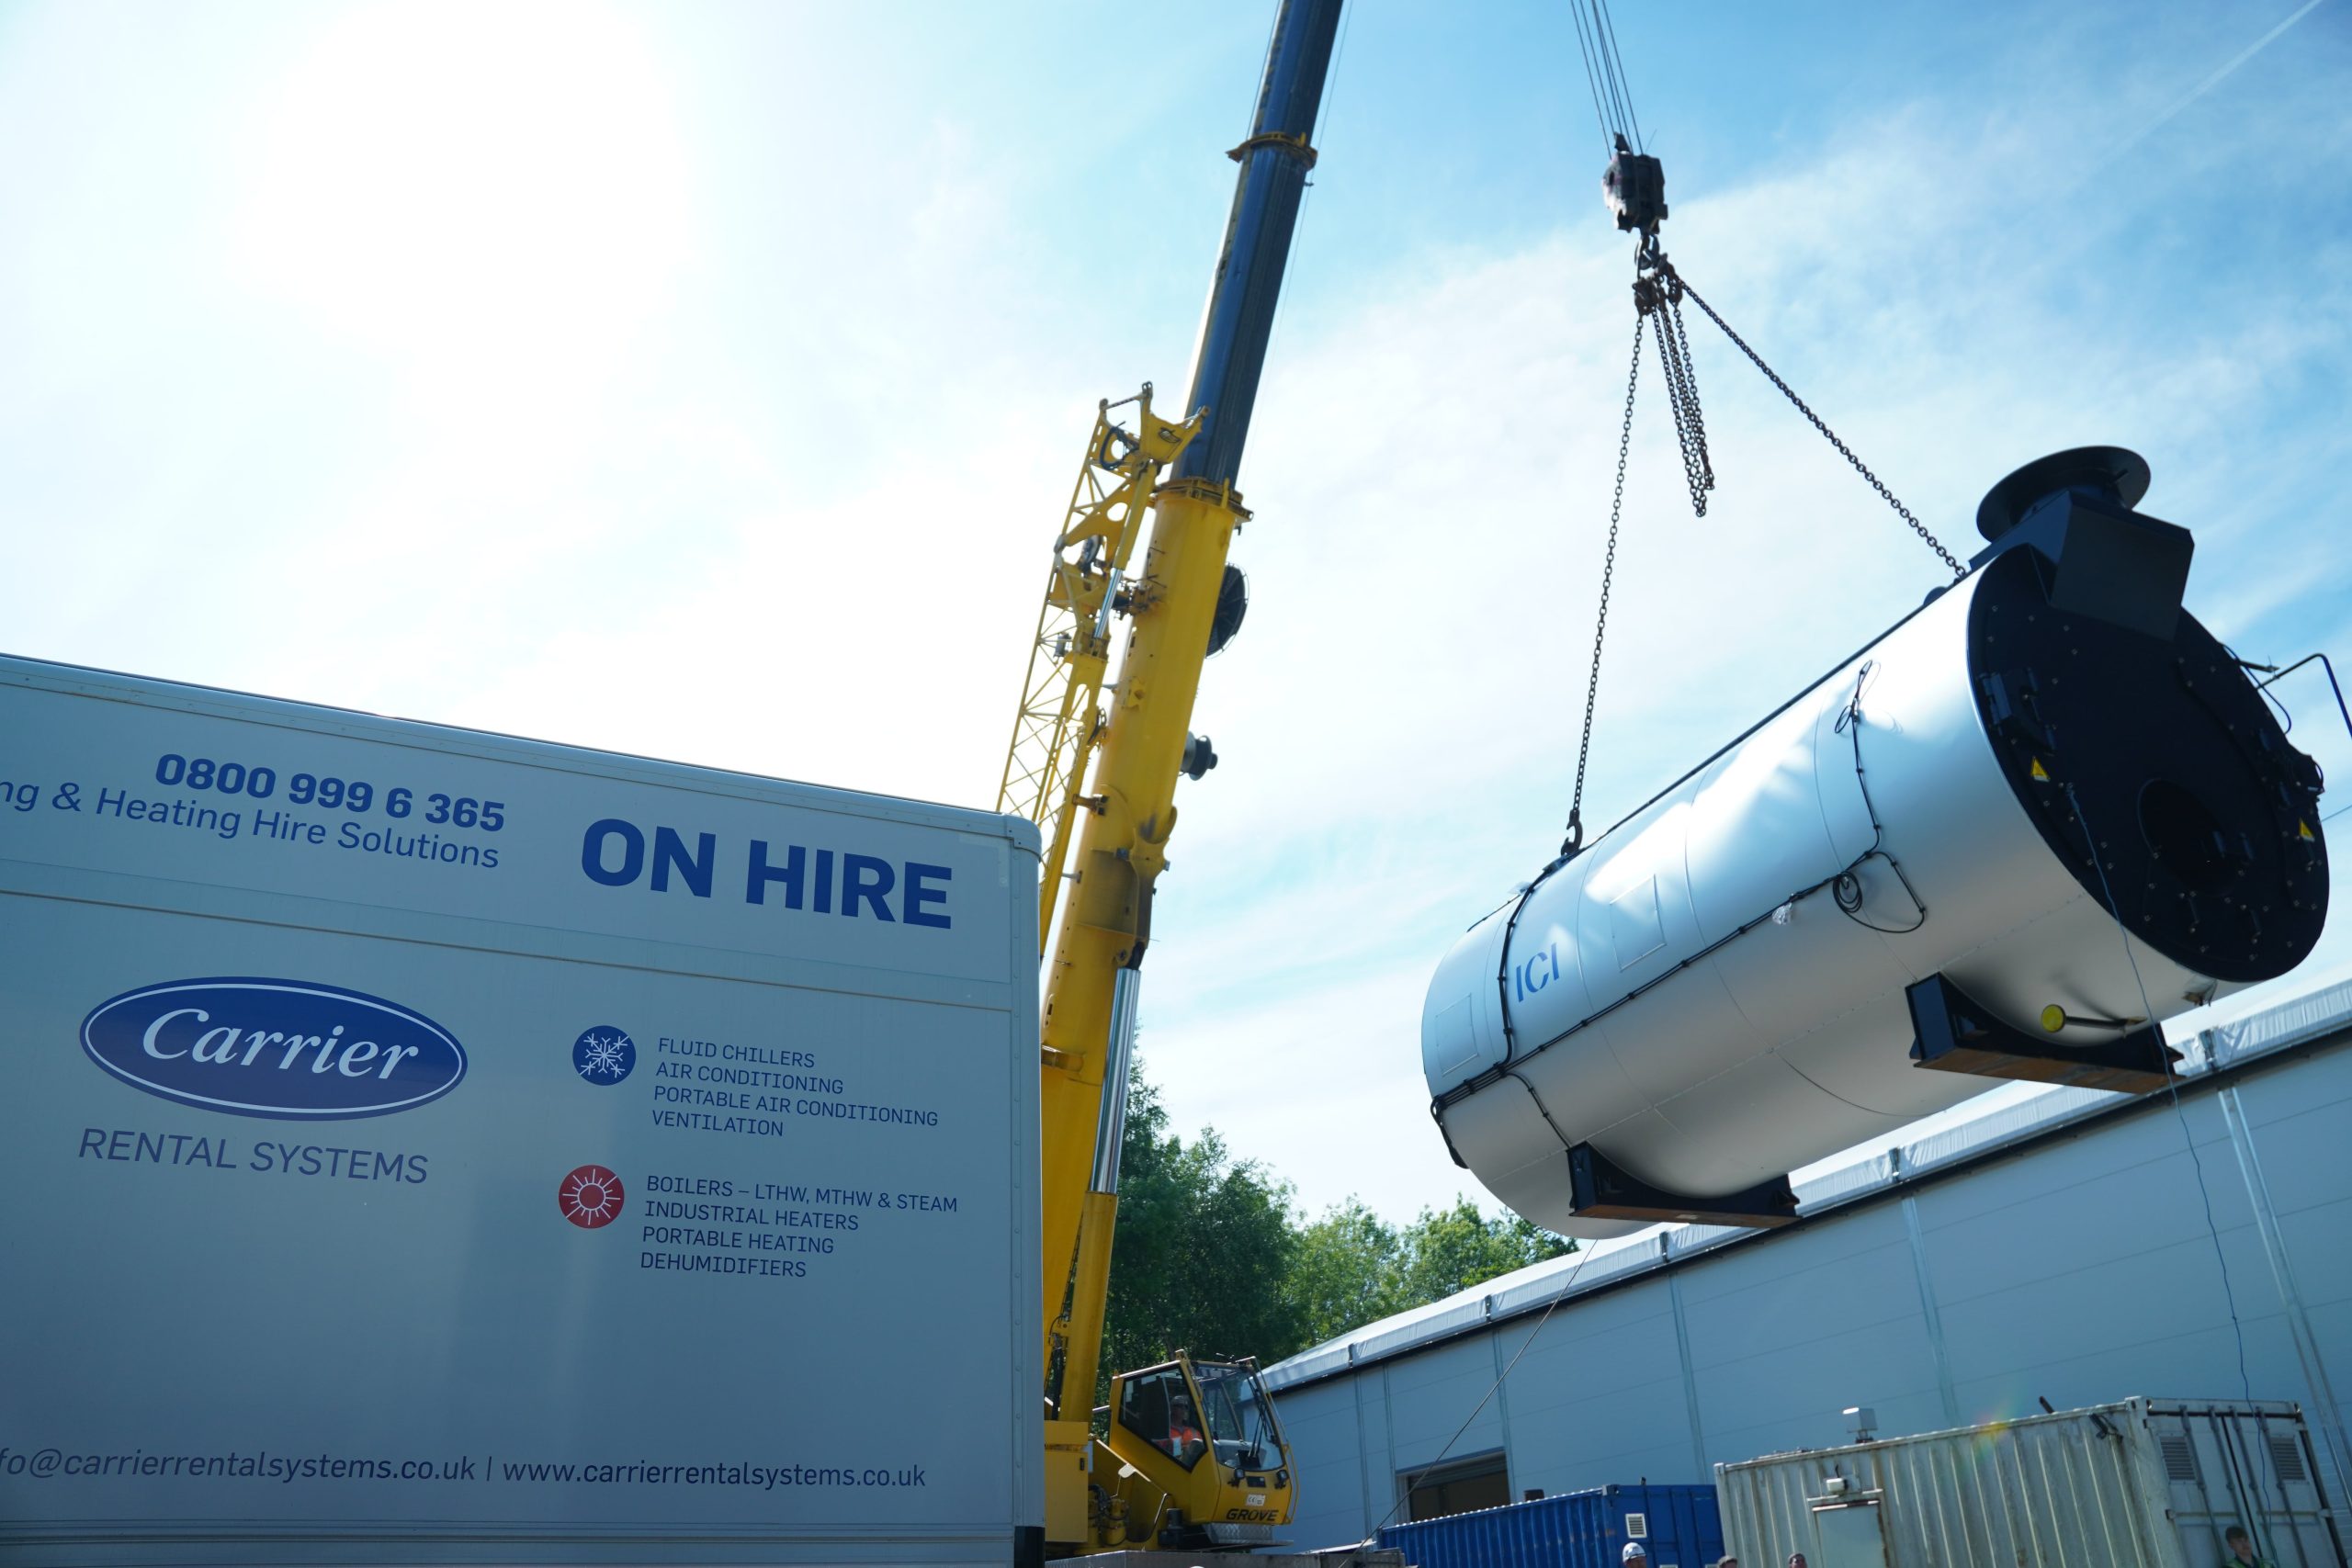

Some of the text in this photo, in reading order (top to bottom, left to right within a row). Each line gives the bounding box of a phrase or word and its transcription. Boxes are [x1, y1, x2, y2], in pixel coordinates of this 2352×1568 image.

[154, 753, 505, 832] 0800 999 6 365
[51, 782, 82, 812] &
[96, 786, 242, 840] Heating
[252, 808, 327, 845] Hire
[337, 821, 500, 869] Solutions
[581, 818, 953, 931] ON HIRE
[1516, 942, 1559, 1003] ICI
[141, 1008, 420, 1079] Carrier
[658, 1037, 815, 1068] FLUID CHILLERS
[655, 1061, 843, 1095] AIR CONDITIONING
[651, 1109, 784, 1137] VENTILATION
[653, 1085, 938, 1127] PORTABLE AIR CONDITIONING
[78, 1127, 429, 1184] RENTAL SYSTEMS
[646, 1175, 733, 1198] BOILERS
[754, 1183, 810, 1205] LTHW,
[815, 1187, 874, 1208] MTHW
[876, 1192, 892, 1209] &
[896, 1193, 958, 1213] STEAM
[644, 1200, 859, 1231] INDUSTRIAL HEATERS
[642, 1225, 834, 1255] PORTABLE HEATING
[640, 1251, 807, 1278] DEHUMIDIFIERS
[503, 1461, 926, 1491] www.carrierrentalsystems.co.uk
[1226, 1508, 1279, 1521] GROVE
